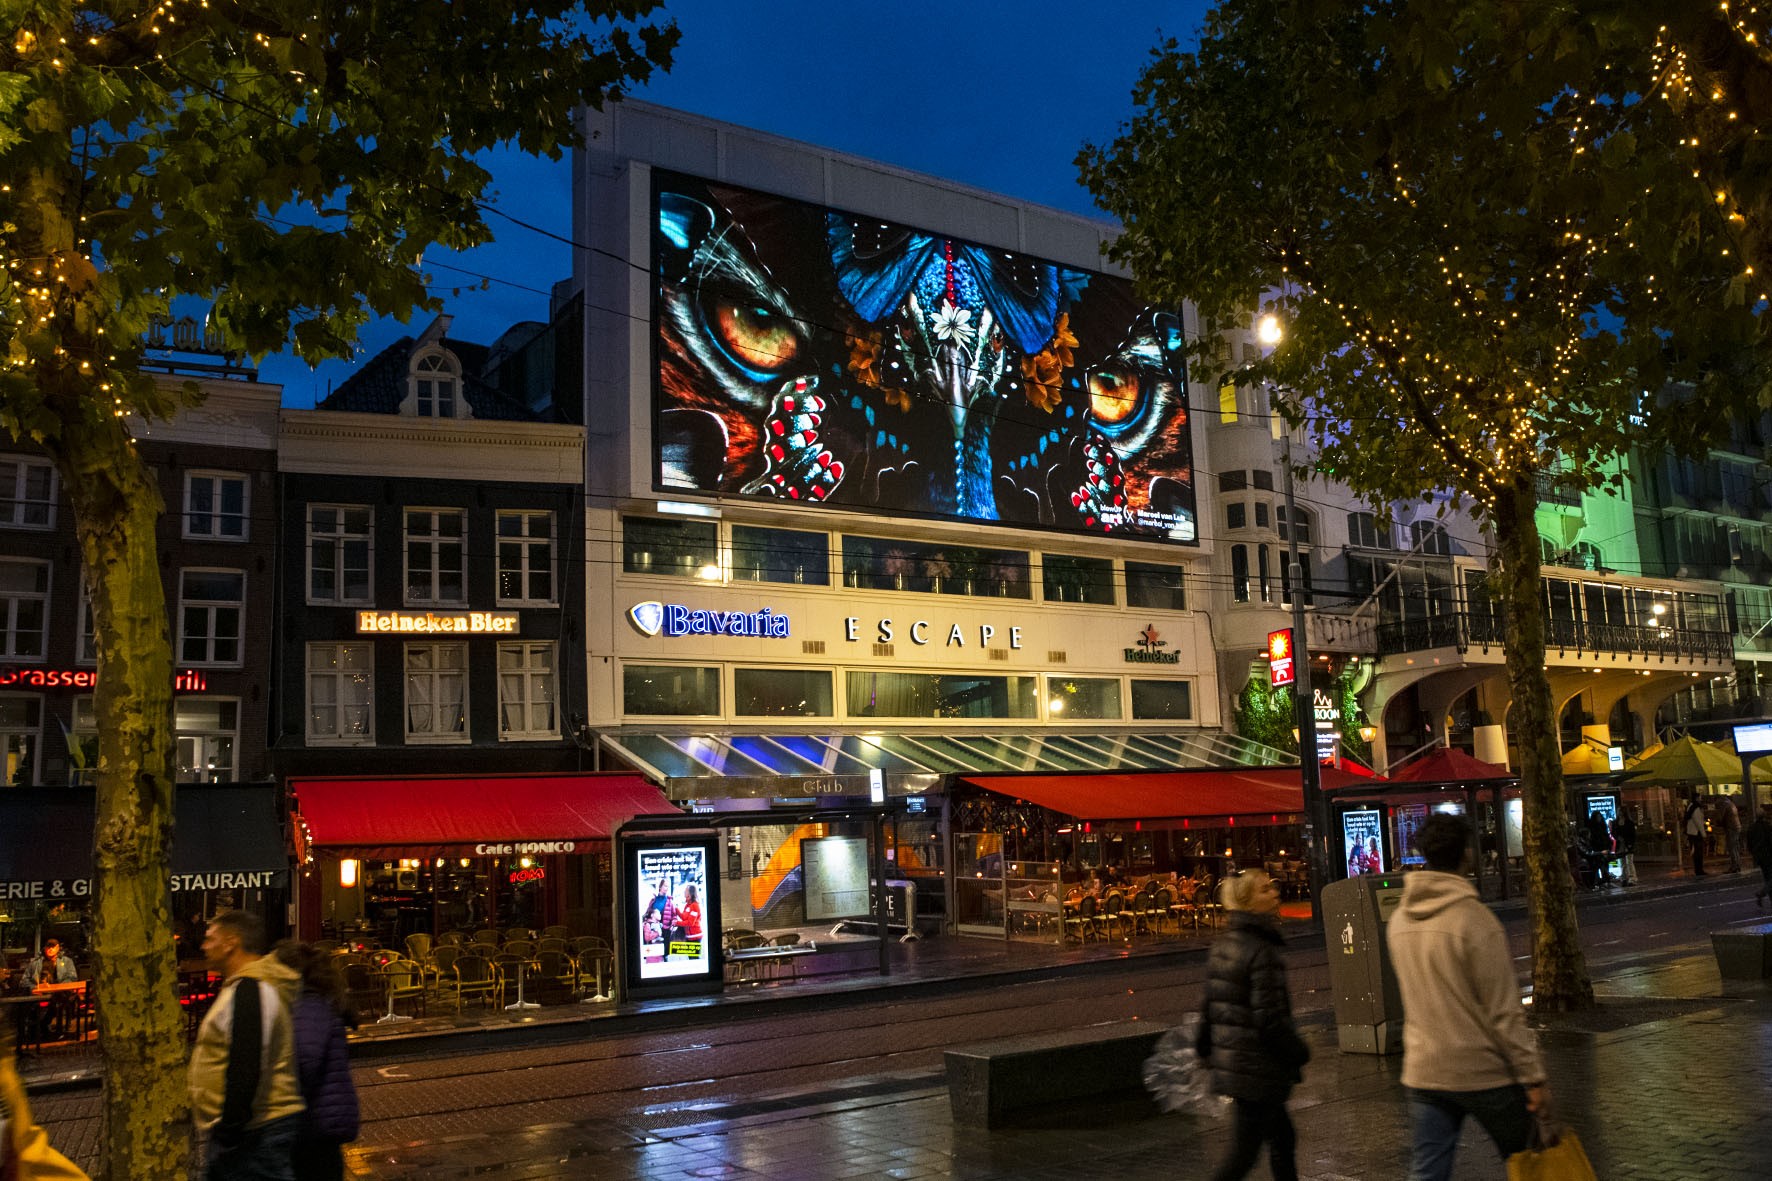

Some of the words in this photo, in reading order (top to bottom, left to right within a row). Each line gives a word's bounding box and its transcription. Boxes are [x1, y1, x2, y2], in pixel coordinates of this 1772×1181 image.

[360, 612, 468, 632] Heineken
[469, 612, 517, 632] Bier
[665, 604, 791, 637] Bavaria
[845, 616, 1022, 650] ESCAPE
[1123, 647, 1181, 665] Heineken
[515, 841, 575, 854] MONICO
